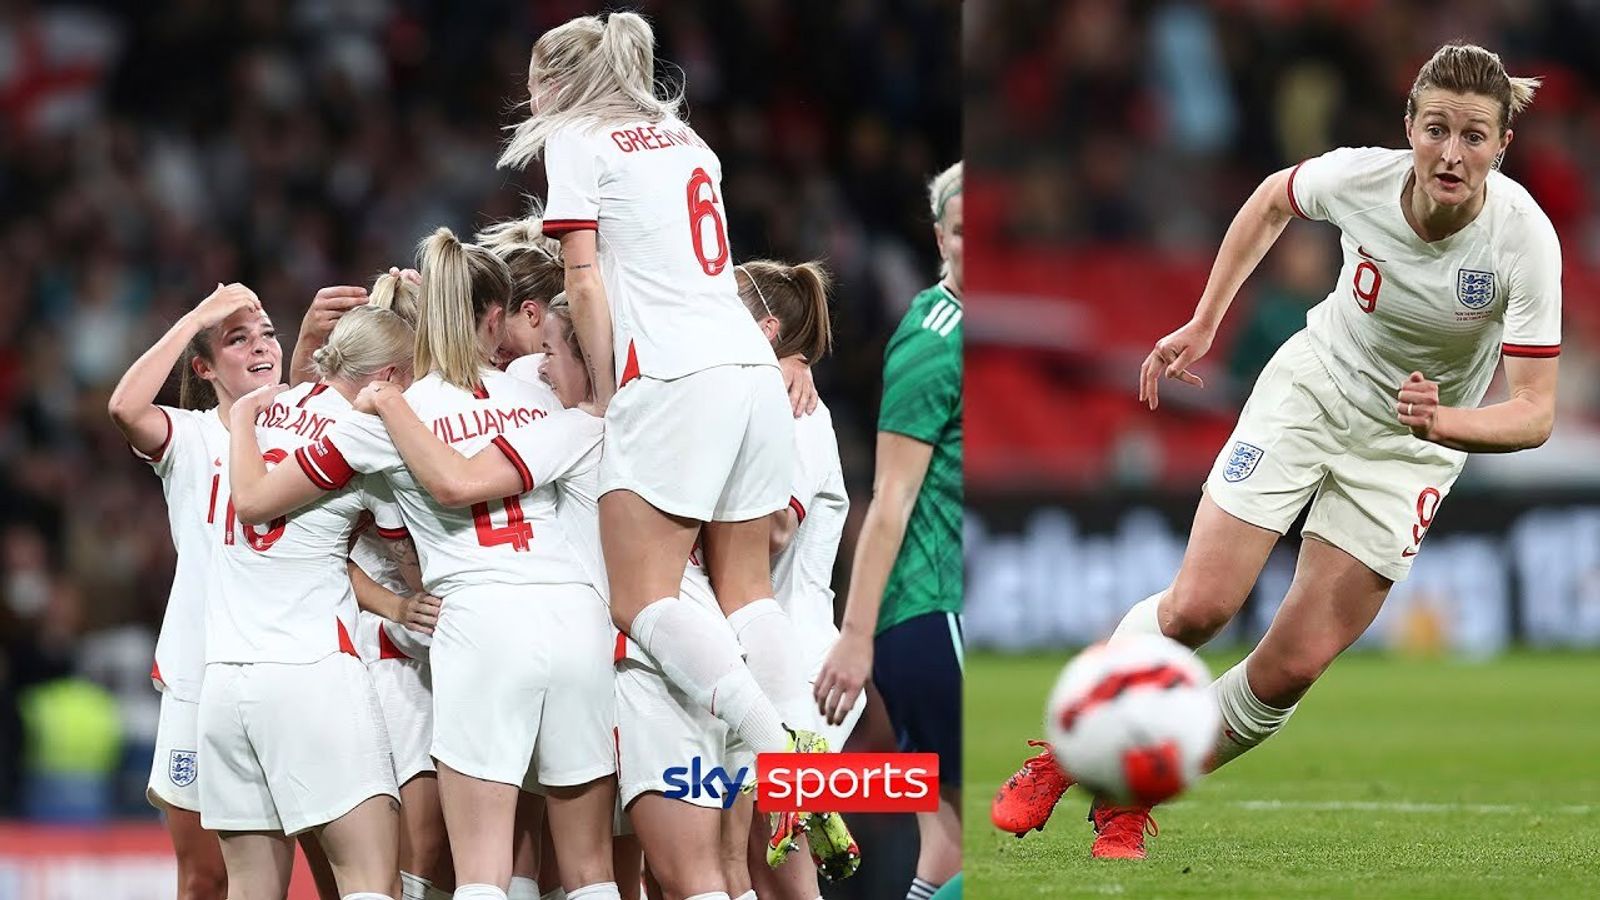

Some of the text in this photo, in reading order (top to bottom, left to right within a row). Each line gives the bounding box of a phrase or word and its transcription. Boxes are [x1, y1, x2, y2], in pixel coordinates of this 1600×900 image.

[686, 167, 729, 276] 6
[1352, 261, 1383, 314] 9
[471, 494, 534, 552] 4
[1412, 487, 1440, 546] 9
